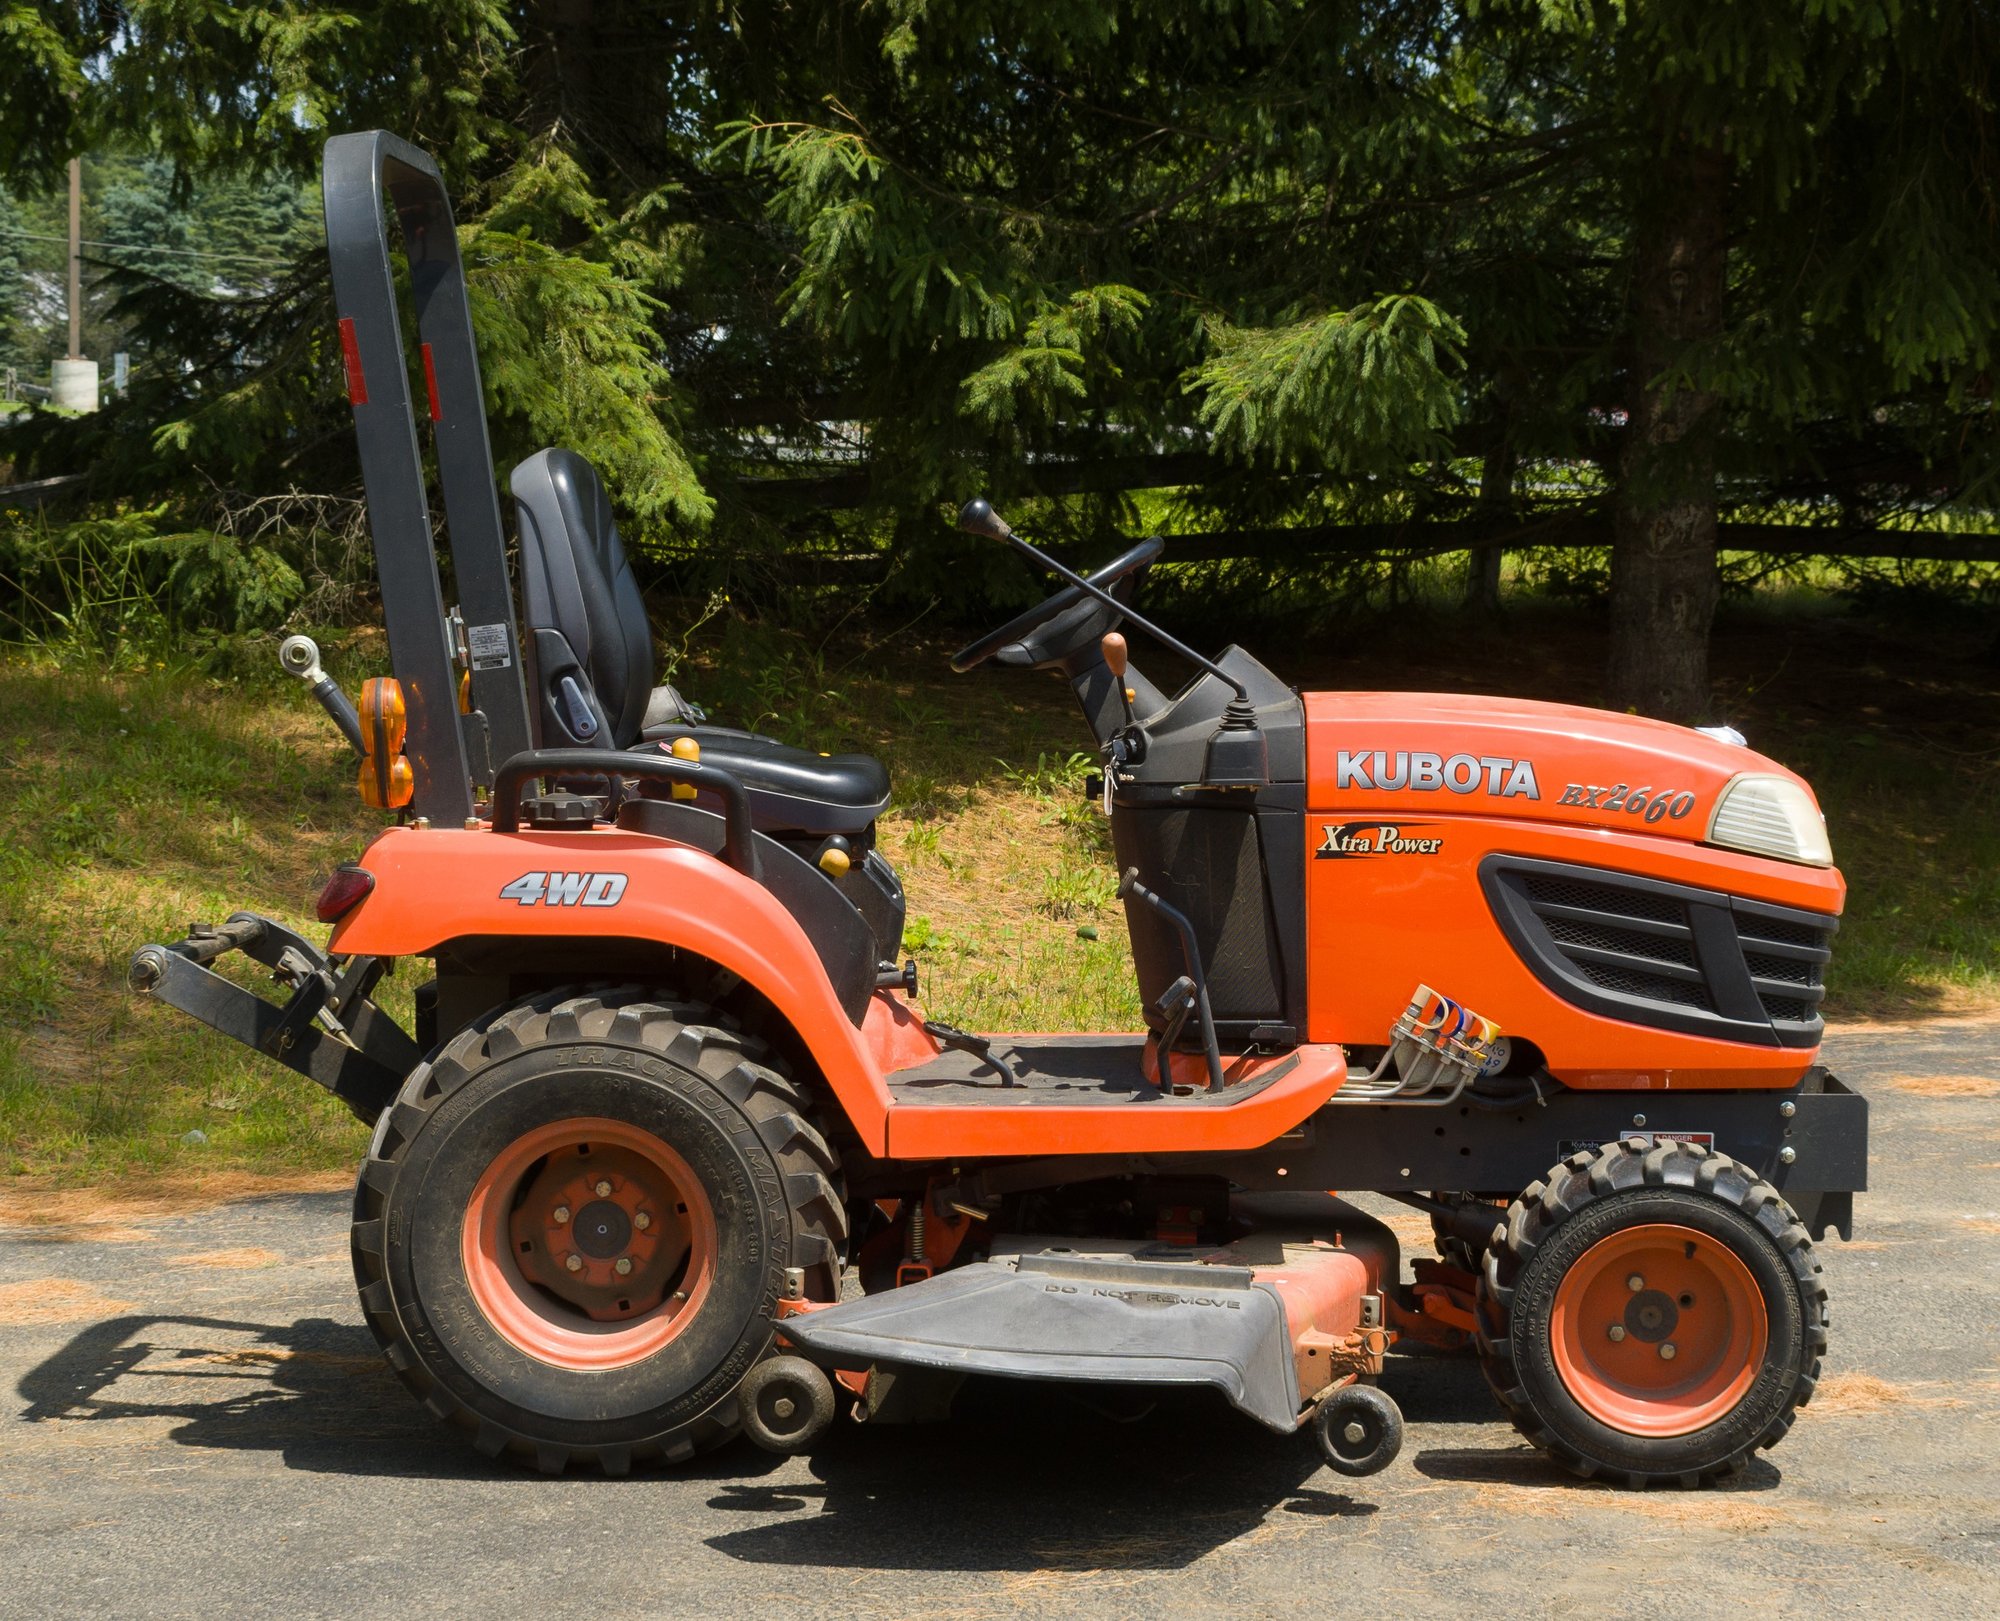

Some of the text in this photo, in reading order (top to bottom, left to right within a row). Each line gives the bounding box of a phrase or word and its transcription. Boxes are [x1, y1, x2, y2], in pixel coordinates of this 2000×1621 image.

[1336, 751, 1540, 800] KUBOTA
[1556, 784, 1696, 823] BX2660
[1317, 825, 1442, 854] Xtra Power
[499, 871, 629, 907] 4WD
[554, 1046, 787, 1323] TRACTION MASTER
[1045, 1284, 1241, 1310] DO NOT REMOVE
